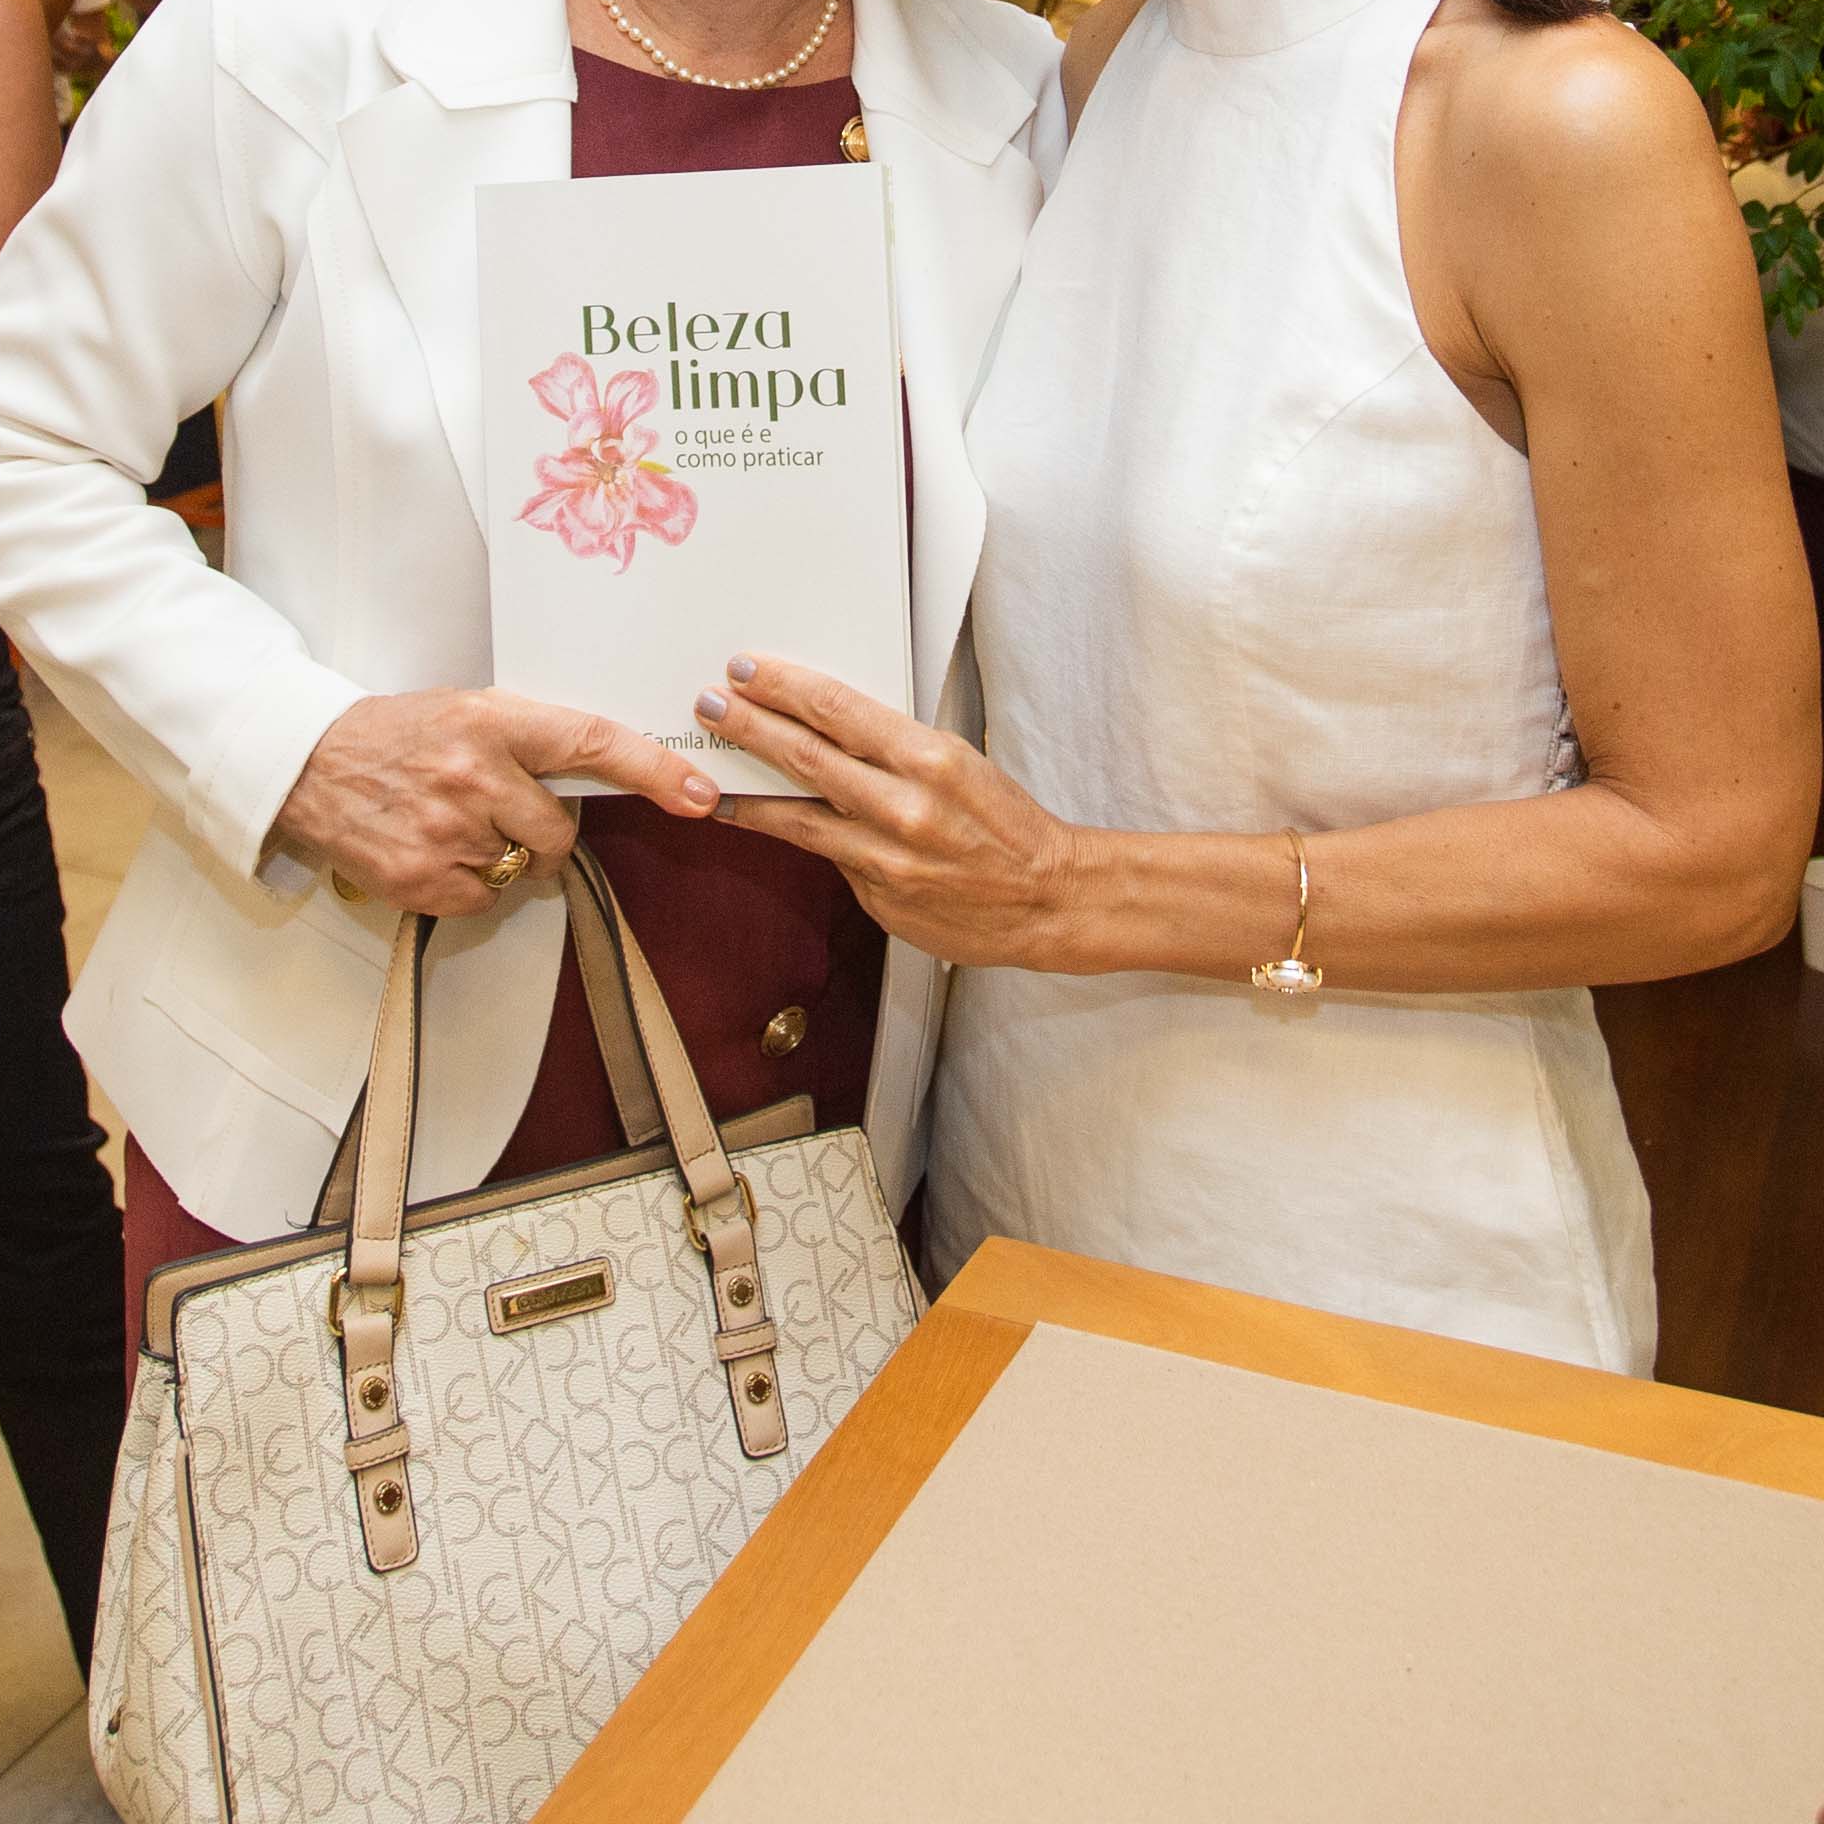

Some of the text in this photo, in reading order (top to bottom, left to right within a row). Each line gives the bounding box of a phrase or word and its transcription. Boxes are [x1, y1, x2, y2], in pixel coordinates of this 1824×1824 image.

[582, 302, 792, 355] Beleza
[670, 359, 847, 422] limpa
[675, 423, 772, 449] o que é e
[675, 447, 824, 472] como praticar
